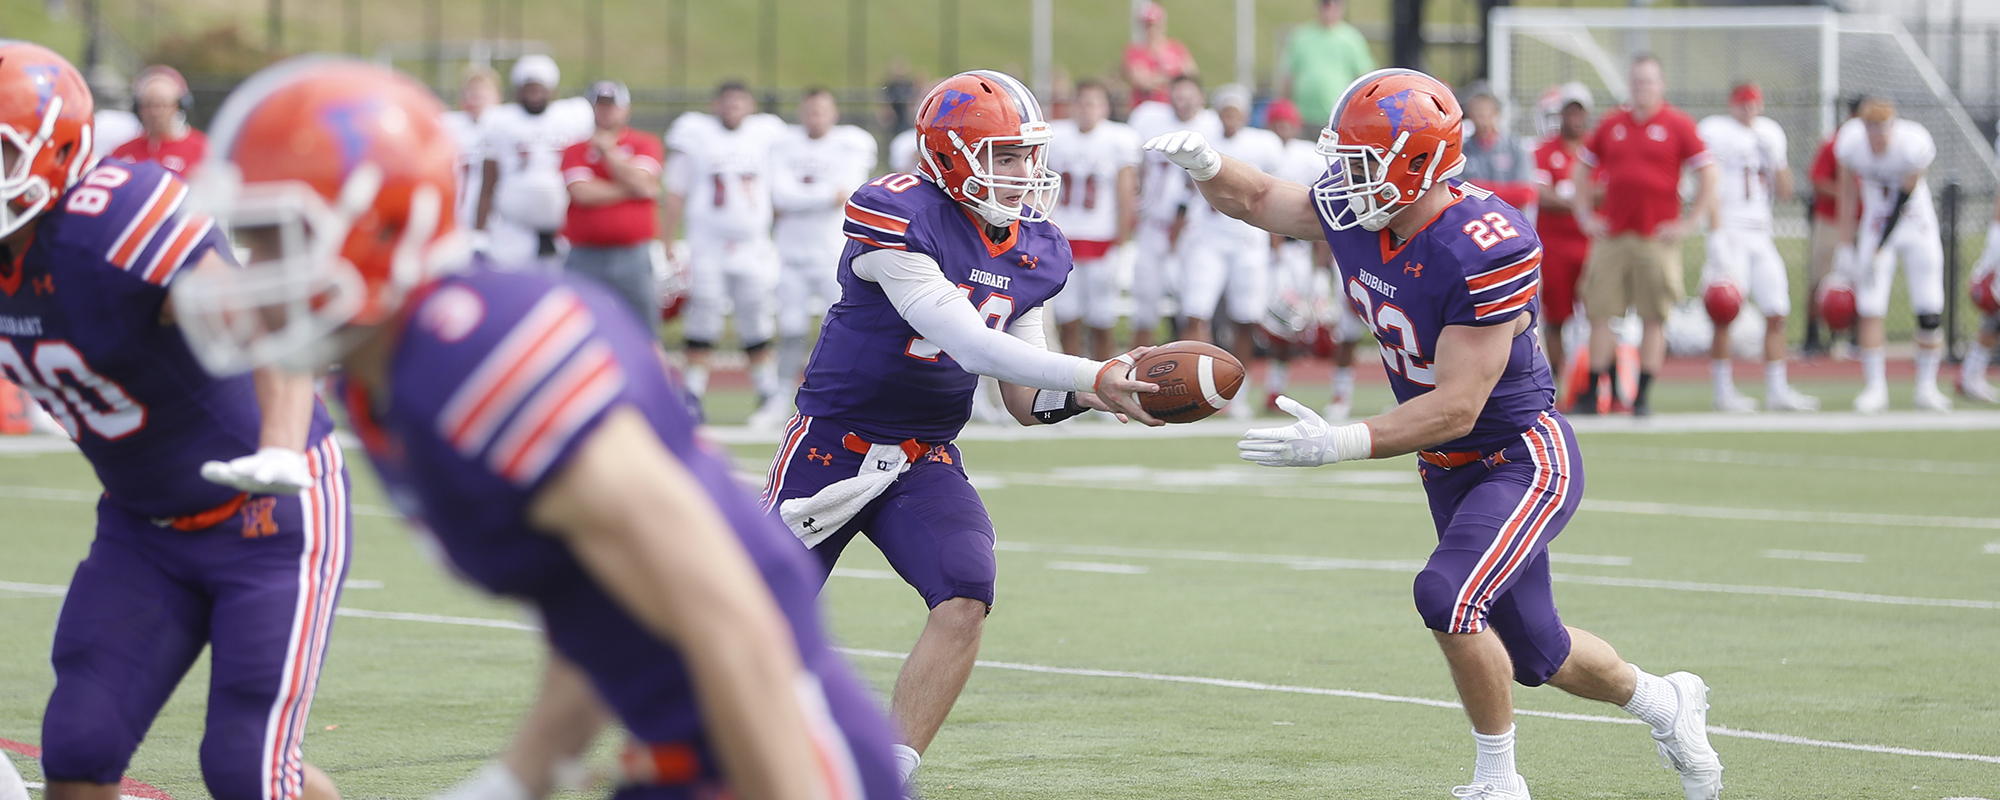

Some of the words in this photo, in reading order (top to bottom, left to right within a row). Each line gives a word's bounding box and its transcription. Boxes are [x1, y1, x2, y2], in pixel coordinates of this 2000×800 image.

[65, 164, 133, 217] 80
[868, 172, 922, 193] 10
[1462, 211, 1521, 251] 22
[968, 268, 1012, 290] HOBART
[1358, 268, 1398, 299] HOBART
[0, 314, 44, 337] OBART
[1347, 275, 1437, 388] 22
[1148, 363, 1176, 377] GST
[1147, 382, 1190, 398] Wils
